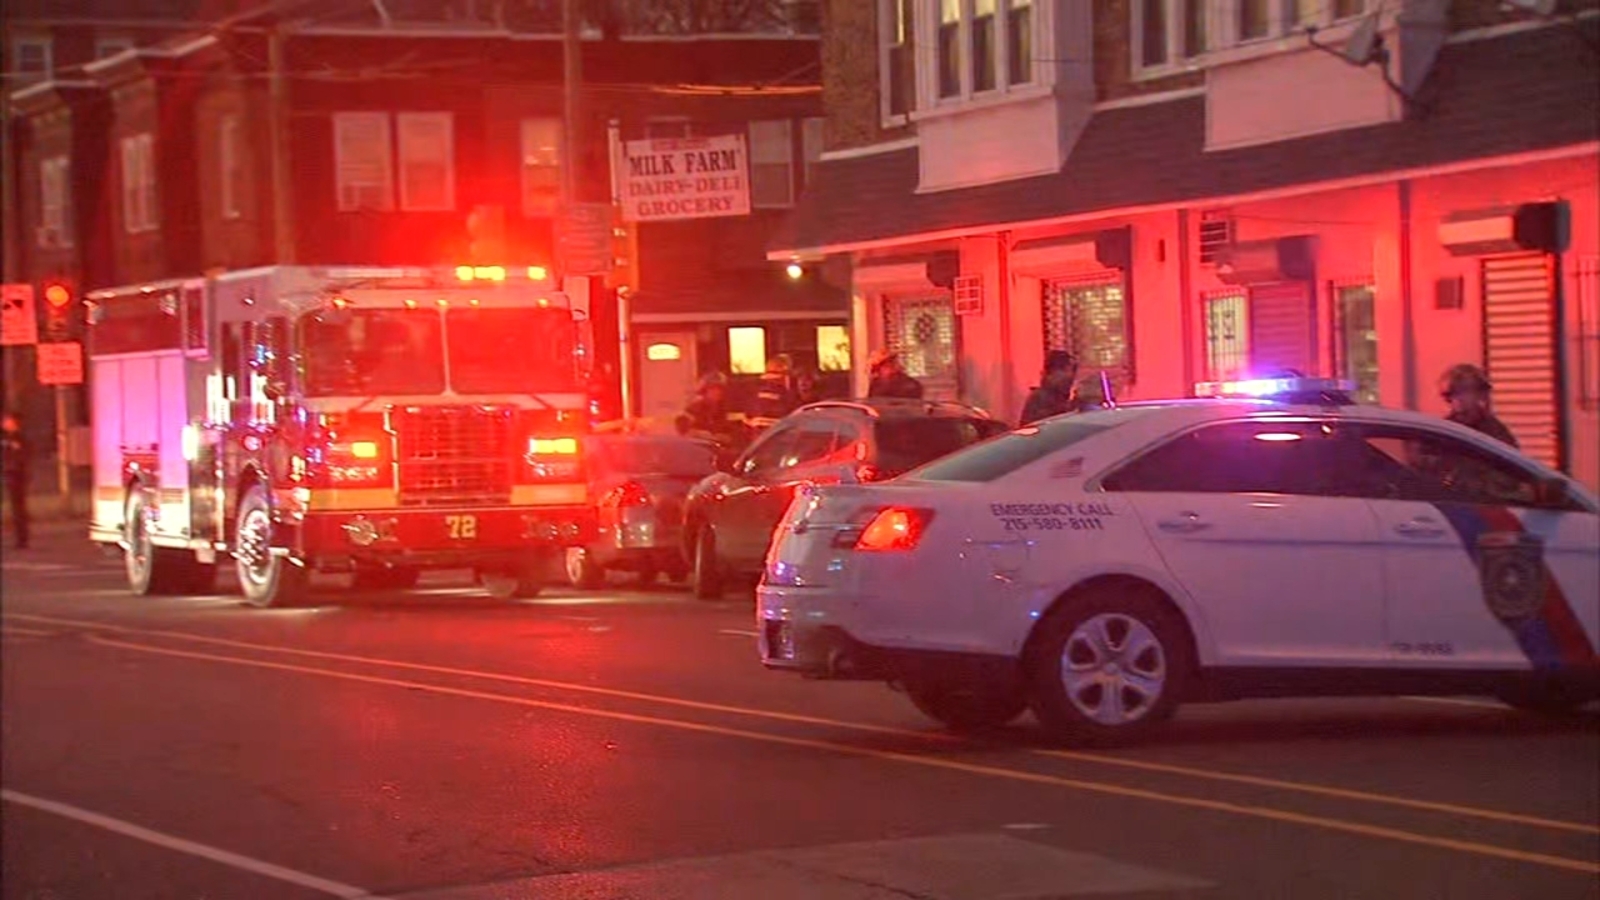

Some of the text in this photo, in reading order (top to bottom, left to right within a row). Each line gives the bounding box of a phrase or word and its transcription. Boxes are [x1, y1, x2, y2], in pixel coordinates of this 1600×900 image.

[629, 149, 736, 177] MILK FARM
[629, 177, 741, 196] DAIRY-DELI
[637, 196, 733, 216] GROCERY
[990, 503, 1114, 516] EMERGENCY CALL
[445, 515, 476, 538] 72
[1000, 518, 1104, 531] 215-580-8111
